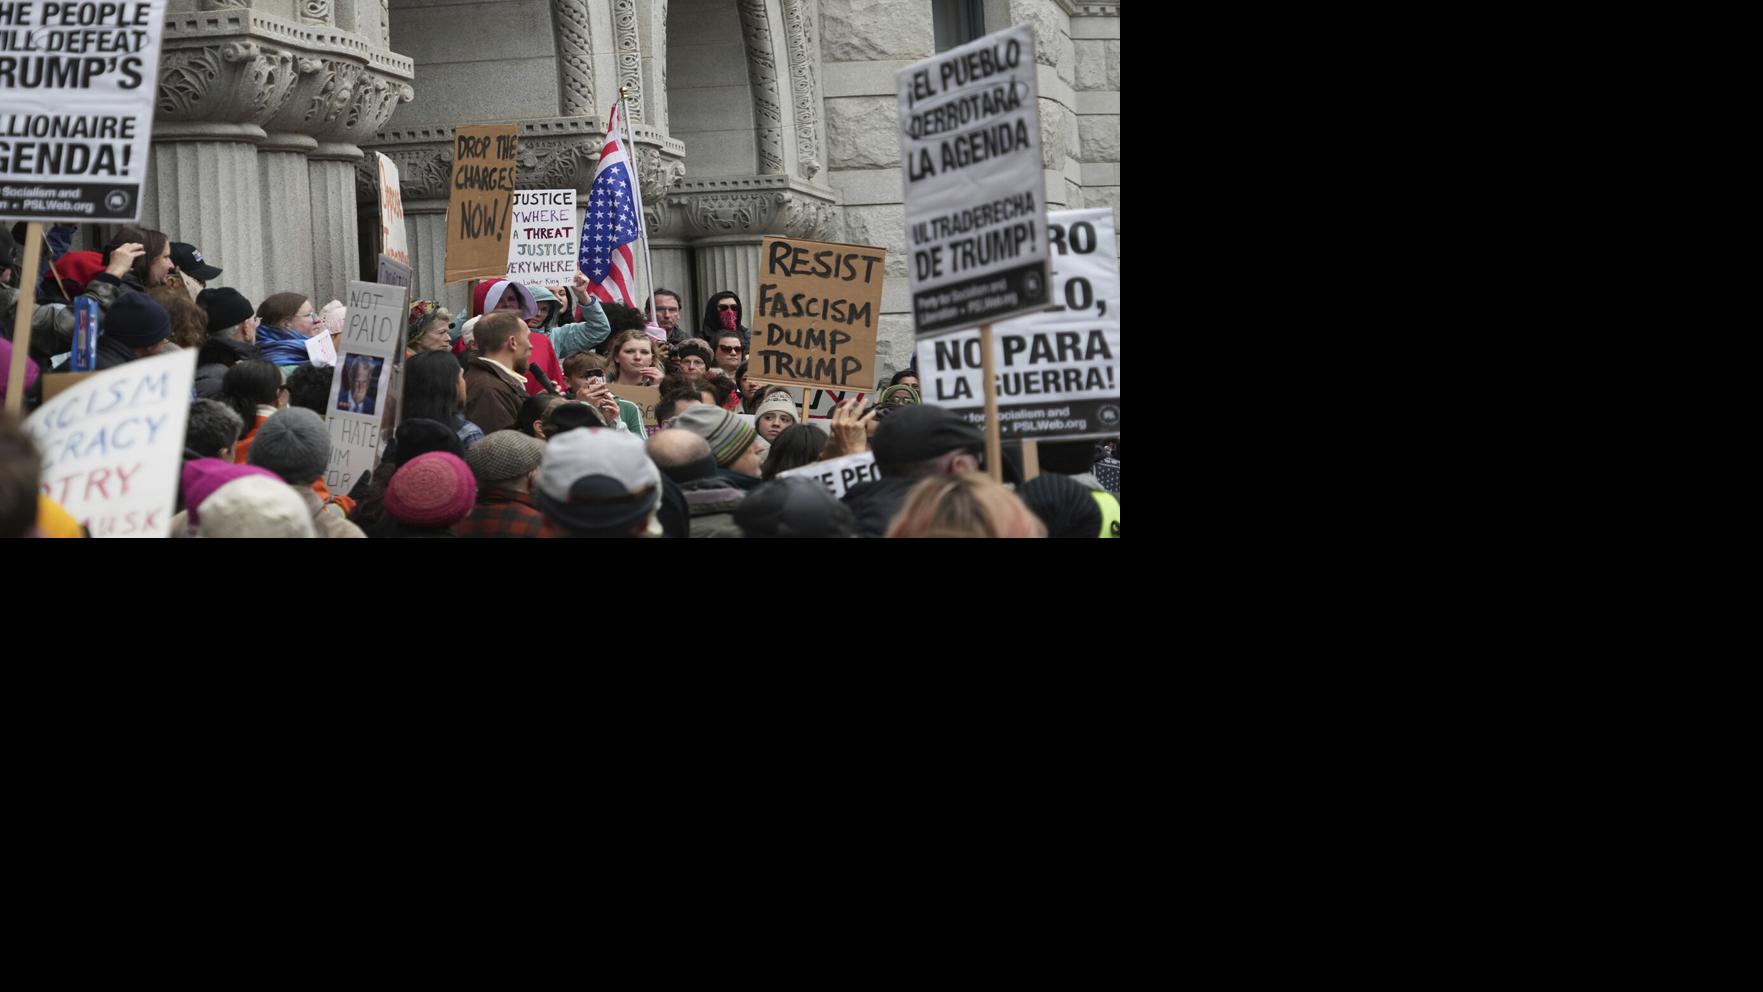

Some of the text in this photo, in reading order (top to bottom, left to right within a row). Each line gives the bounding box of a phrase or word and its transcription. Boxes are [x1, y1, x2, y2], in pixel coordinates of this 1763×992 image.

[41, 2, 151, 26] PEOPLE
[0, 30, 147, 53] ILL DEFEAT
[940, 39, 1020, 91] PUEBLO
[911, 75, 1021, 138] DERROTARÁ
[0, 115, 136, 139] LIONAIRE
[457, 134, 517, 160] DROP THE
[909, 117, 1030, 182] LA AGENDA
[455, 165, 514, 192] CHARGES
[58, 189, 81, 198] and
[513, 192, 573, 205] JUSTICE
[460, 194, 511, 242] NOW!
[514, 209, 569, 222] YWHERE
[913, 191, 1036, 245] ULTRADERECHA
[524, 227, 574, 239] THREAT
[517, 243, 575, 256] JUSTICE
[769, 241, 882, 283] RESIST
[915, 220, 1036, 282] DE TRUMP!
[350, 291, 383, 309] NOT
[759, 284, 871, 328] FASCISM
[1045, 276, 1106, 316] O,
[347, 314, 393, 343] PAID
[935, 330, 1113, 371] NO PARA
[757, 350, 862, 385] TRUMP
[936, 376, 973, 401] LA
[31, 372, 168, 437] SCISM
[998, 409, 1045, 421] ocialism
[1048, 407, 1070, 417] and
[341, 419, 378, 448] HATE
[44, 463, 141, 504] TRY
[84, 507, 163, 535] USK
